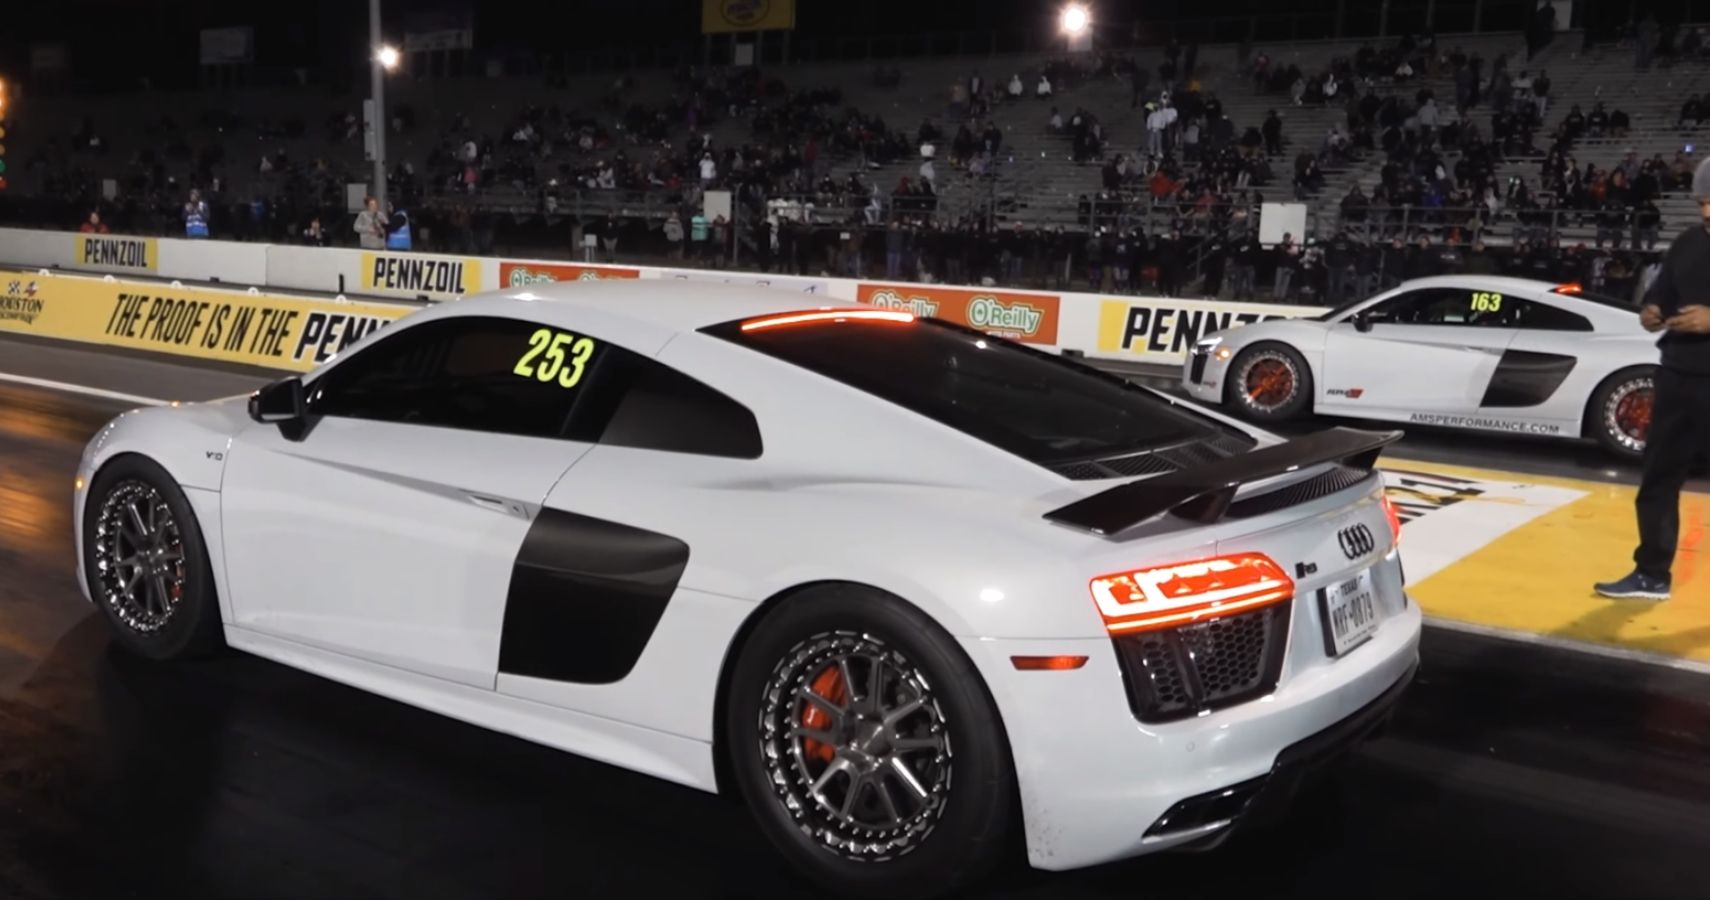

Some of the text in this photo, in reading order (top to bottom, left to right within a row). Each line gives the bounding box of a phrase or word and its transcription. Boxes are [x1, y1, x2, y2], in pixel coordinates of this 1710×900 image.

[84, 238, 148, 267] PENNZOIL
[373, 257, 466, 293] PENNZOIL
[971, 297, 1039, 332] O'Reilly
[1471, 293, 1502, 312] 163
[105, 293, 150, 337] THE
[139, 297, 210, 345] PROOF
[200, 304, 231, 349] IS
[223, 306, 256, 352] IN
[249, 308, 299, 357] THE
[513, 328, 594, 388] 253
[1410, 413, 1560, 434] AMSPERFORMANCE.COM
